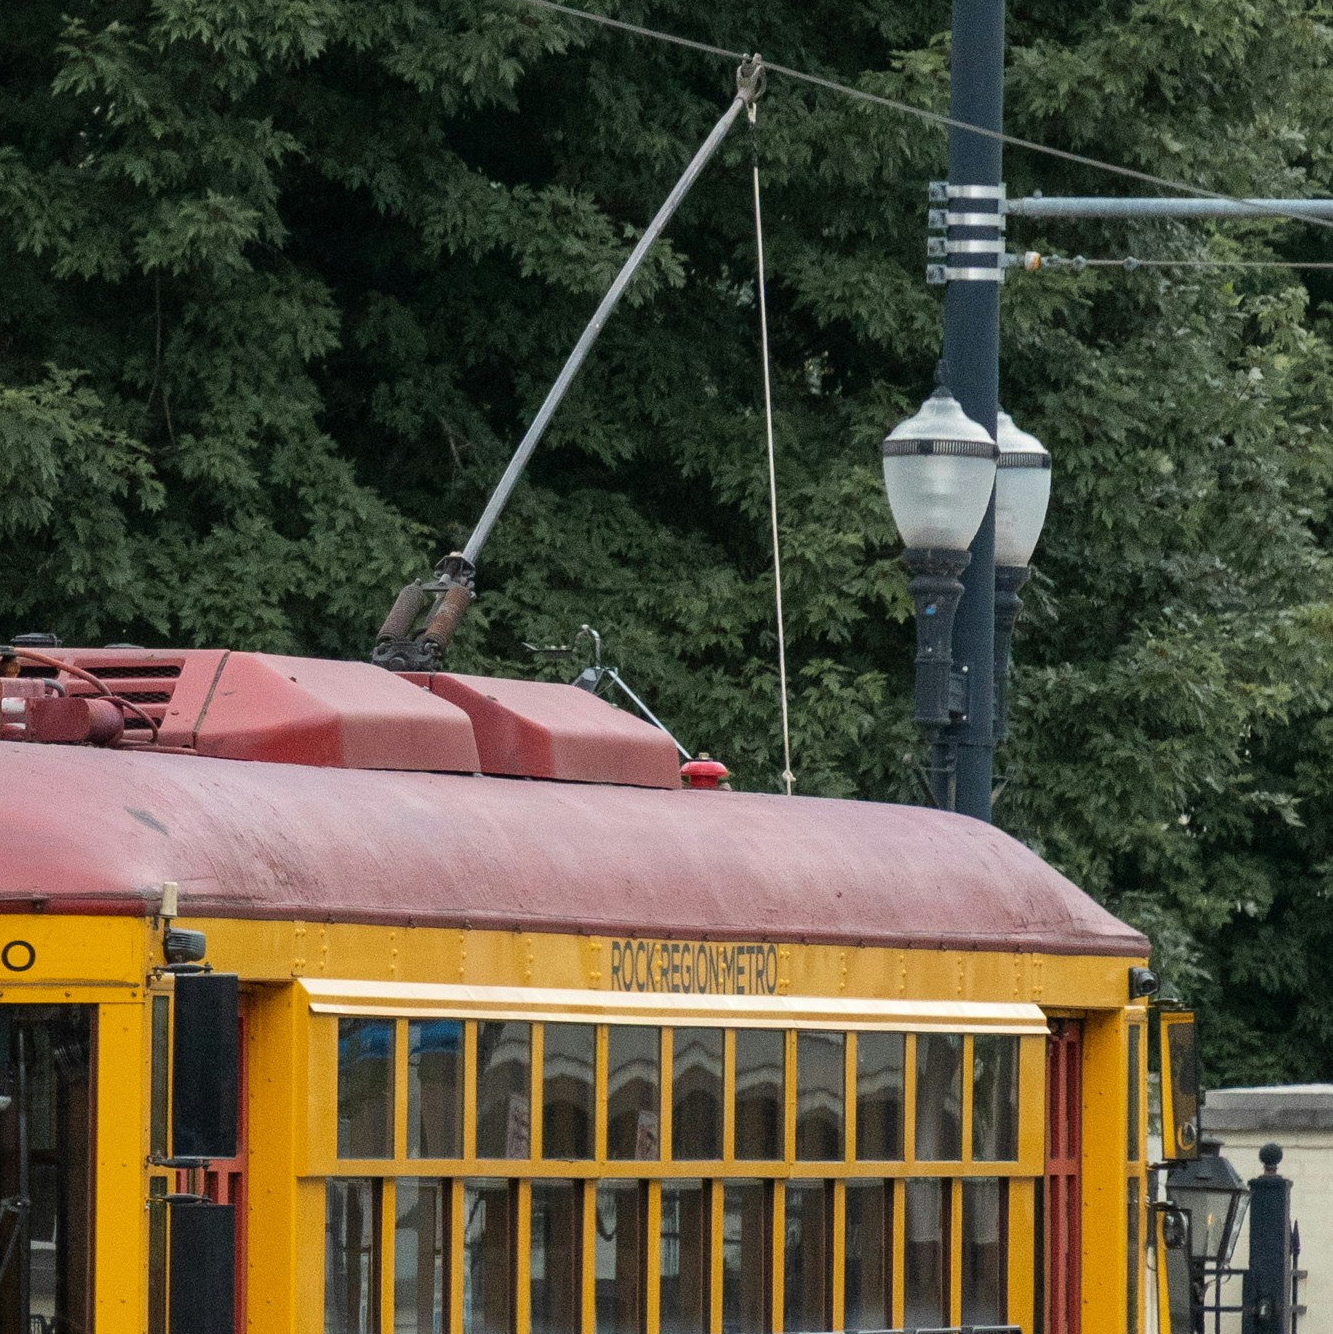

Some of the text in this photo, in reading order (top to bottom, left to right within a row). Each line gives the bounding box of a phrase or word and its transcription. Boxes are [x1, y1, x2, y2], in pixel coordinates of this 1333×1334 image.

[611, 940, 778, 996] ROCK REGION METRO
